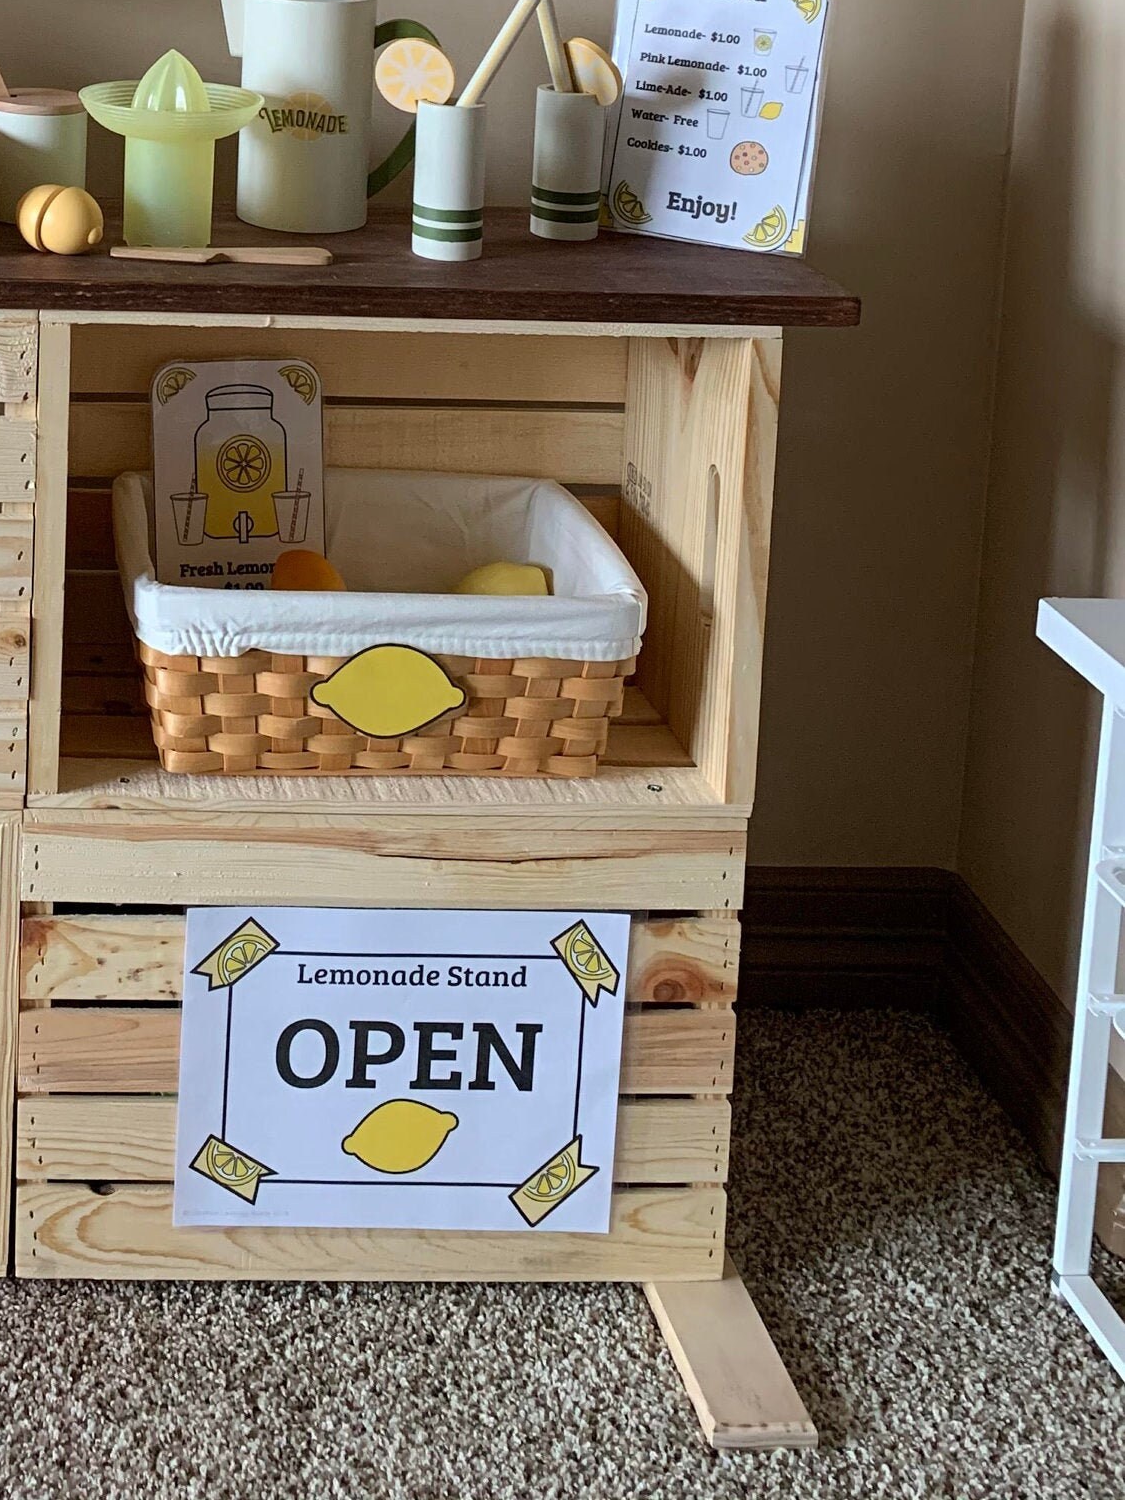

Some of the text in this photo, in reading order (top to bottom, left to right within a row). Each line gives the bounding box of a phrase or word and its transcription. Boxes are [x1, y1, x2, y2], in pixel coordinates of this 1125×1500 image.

[644, 23, 740, 45] Lemonade- $1.00
[640, 52, 767, 78] Pink Lemonade- $1.00
[698, 88, 728, 102] $1.00
[258, 107, 346, 134] LEMONADE
[631, 108, 699, 128] Water- Free
[627, 137, 707, 159] Cookies- $1.00
[666, 191, 737, 224] Enjoy!
[179, 561, 224, 578] Fresh
[297, 963, 528, 988] Lemonade Stand
[275, 1018, 543, 1092] OPEN
